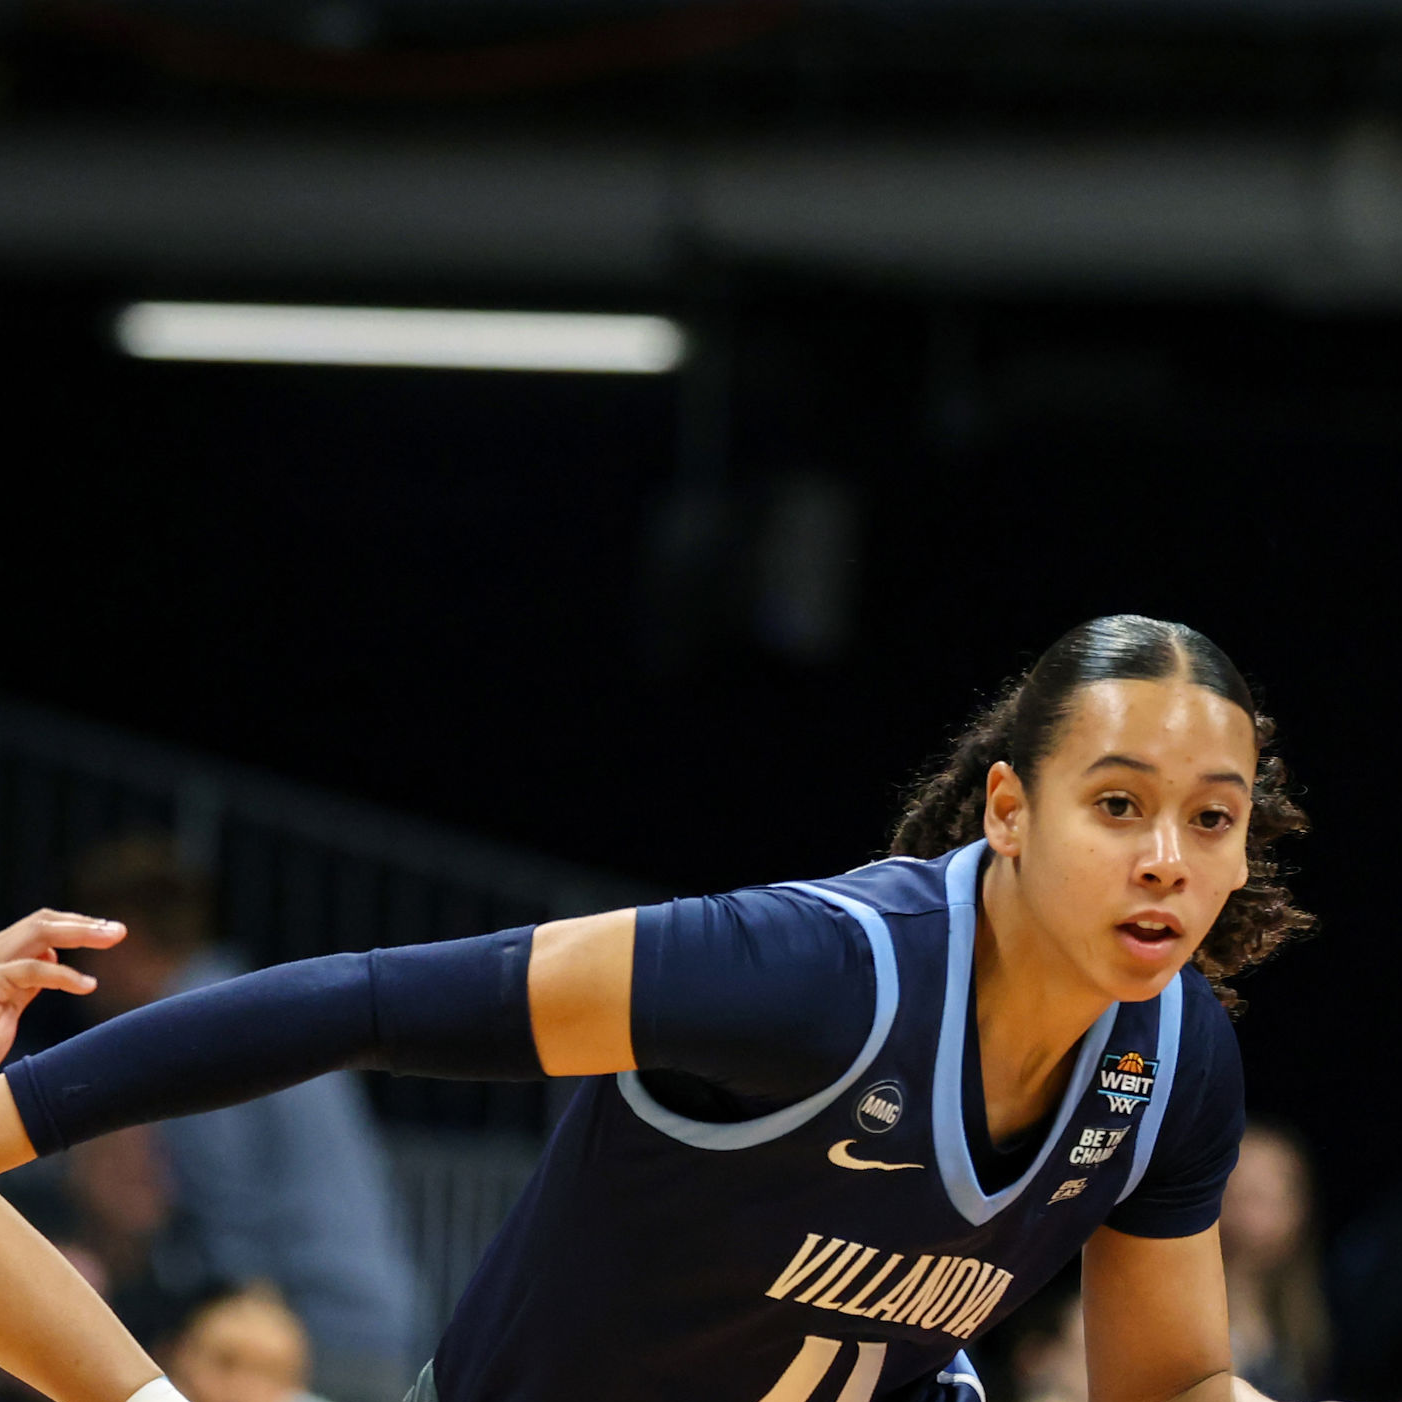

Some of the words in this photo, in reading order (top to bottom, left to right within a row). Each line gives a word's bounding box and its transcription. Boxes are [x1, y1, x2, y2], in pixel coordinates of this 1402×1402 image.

[1100, 1070, 1155, 1095] WBIT
[861, 1095, 901, 1124] MMG
[1078, 1129, 1106, 1147] BE
[1106, 1130, 1128, 1147] TH
[764, 1232, 1015, 1339] VILLANOVA
